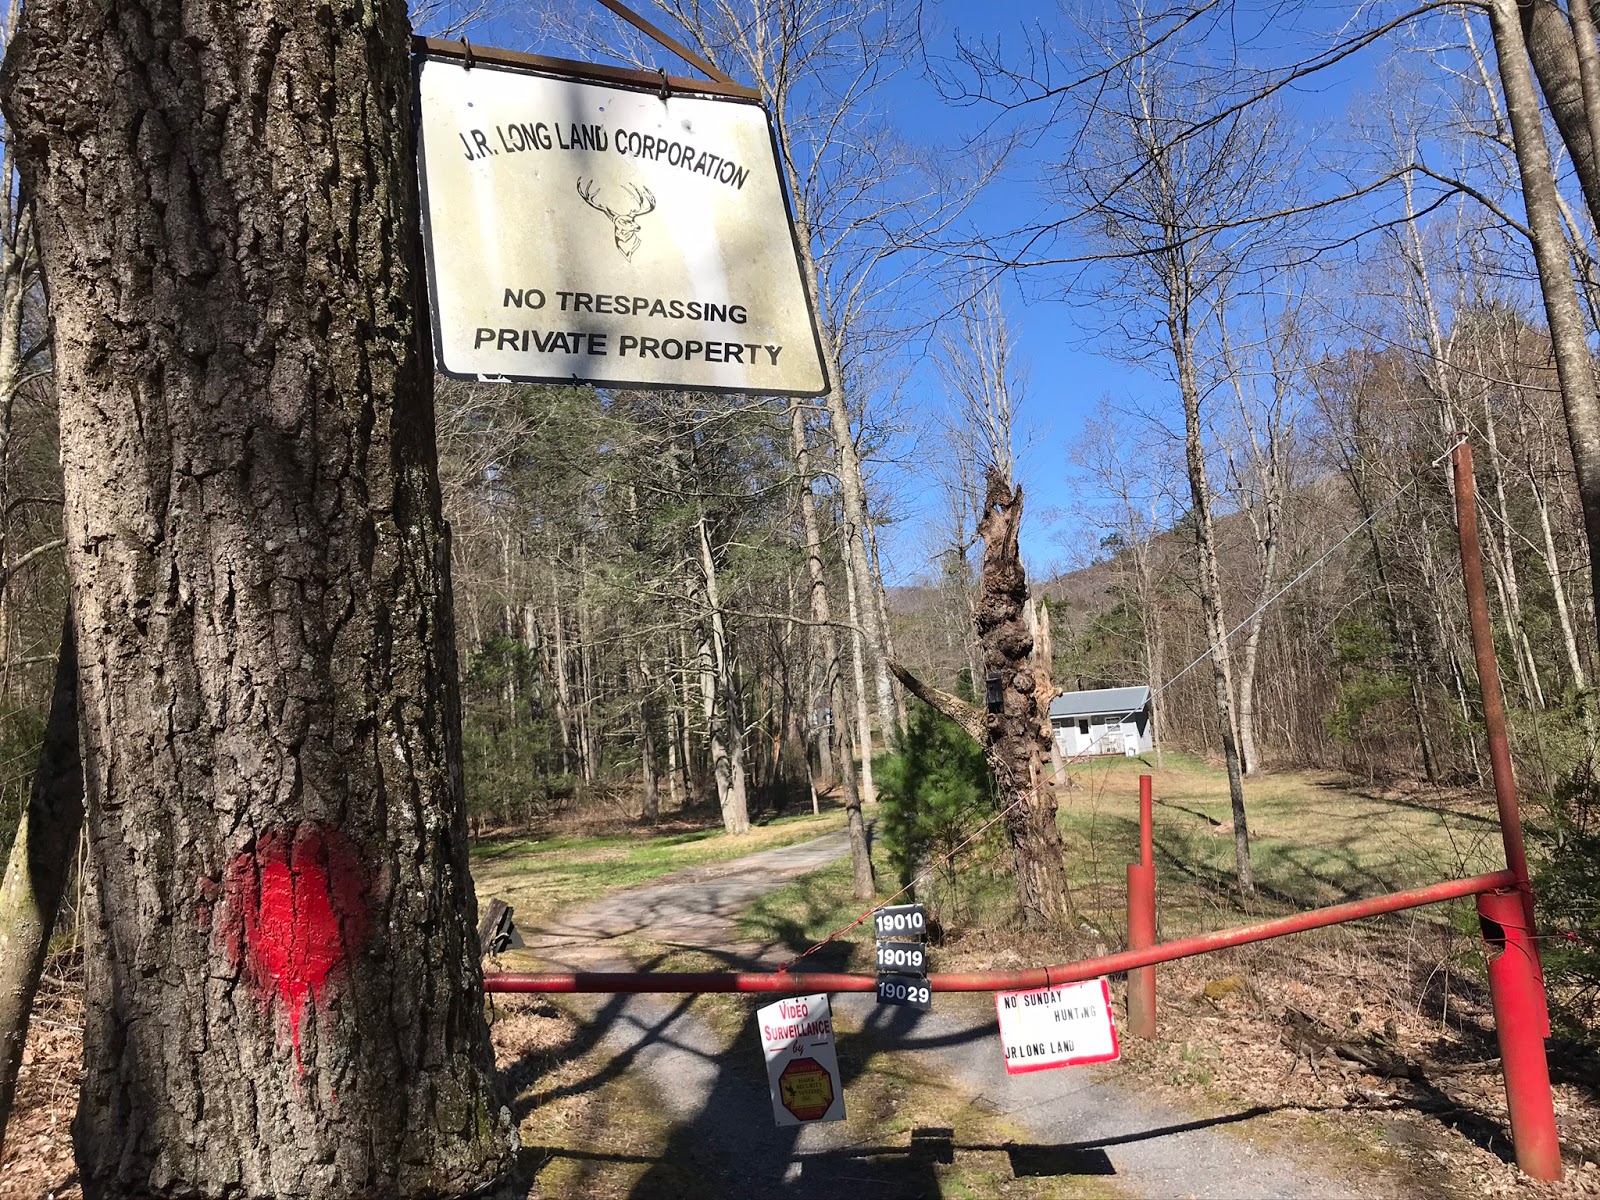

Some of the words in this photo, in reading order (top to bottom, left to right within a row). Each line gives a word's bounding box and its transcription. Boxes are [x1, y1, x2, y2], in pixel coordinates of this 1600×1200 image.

[459, 128, 498, 161] J.R.
[496, 122, 552, 154] LONG
[557, 122, 608, 151] LAND
[614, 128, 751, 191] CORPORATION
[502, 287, 546, 310] NO
[556, 291, 748, 325] TRESPASSING
[474, 327, 608, 356] PRIVATE
[619, 335, 783, 367] PROPERTY
[876, 912, 924, 932] 19010
[877, 949, 923, 967] 19019
[879, 982, 930, 1004] 19029
[1004, 996, 1017, 1009] NO
[1024, 990, 1063, 1007] SUNDAY
[792, 1040, 805, 1056] by
[1050, 1040, 1075, 1054] LAND
